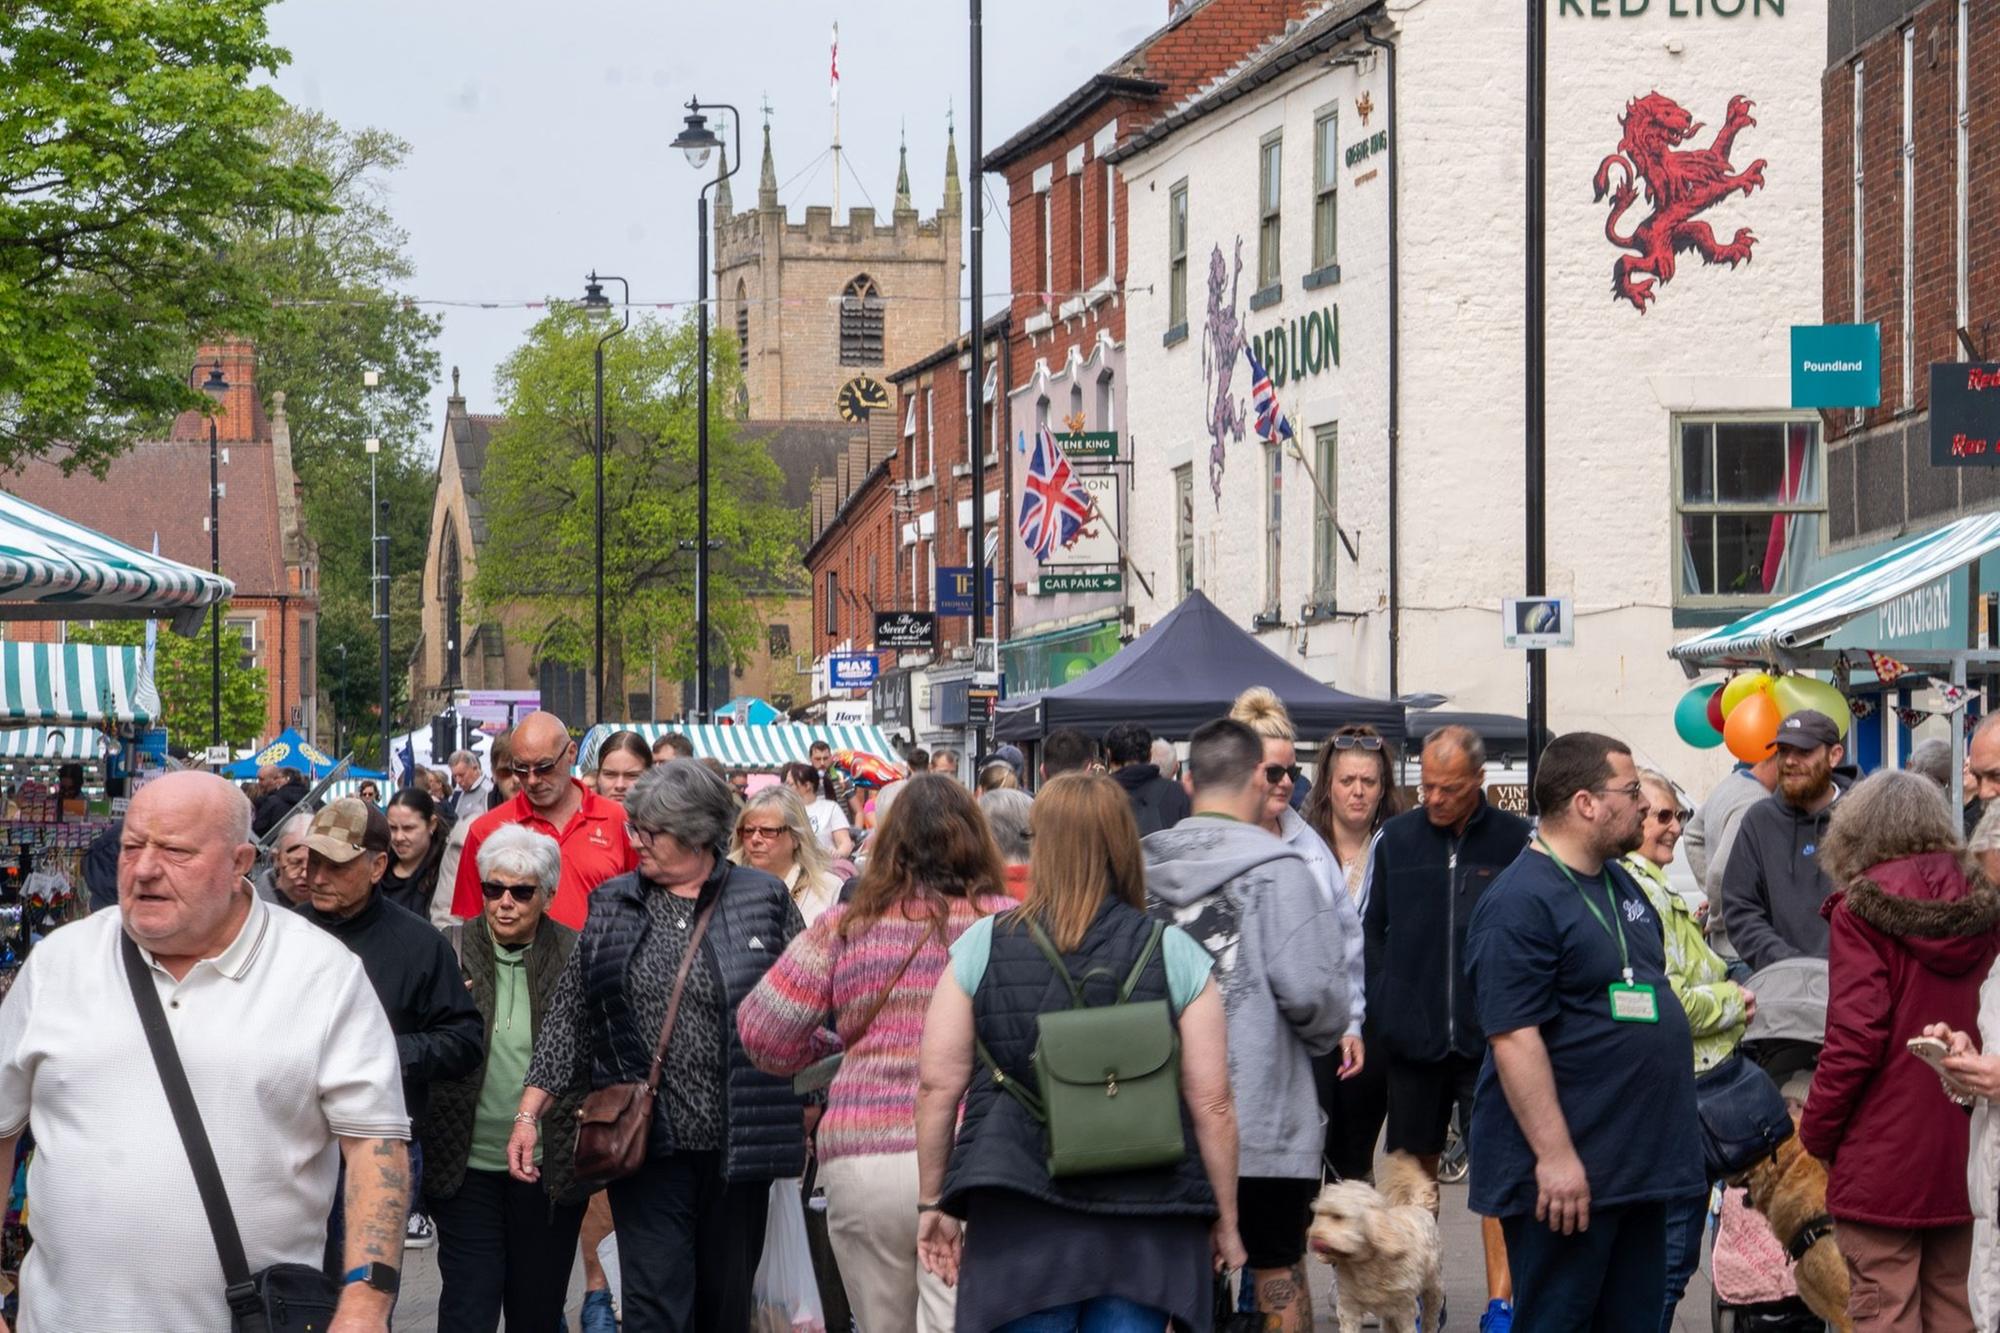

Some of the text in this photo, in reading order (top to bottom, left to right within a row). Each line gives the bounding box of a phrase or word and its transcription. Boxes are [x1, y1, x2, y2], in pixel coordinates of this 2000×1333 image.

[1290, 302, 1340, 382] LION
[1803, 359, 1862, 373] Poundland
[1085, 439, 1110, 449] KING
[1044, 578, 1100, 590] CAR PARK
[878, 621, 907, 634] Sweet
[837, 660, 871, 671] MAX
[835, 711, 862, 722] Hays
